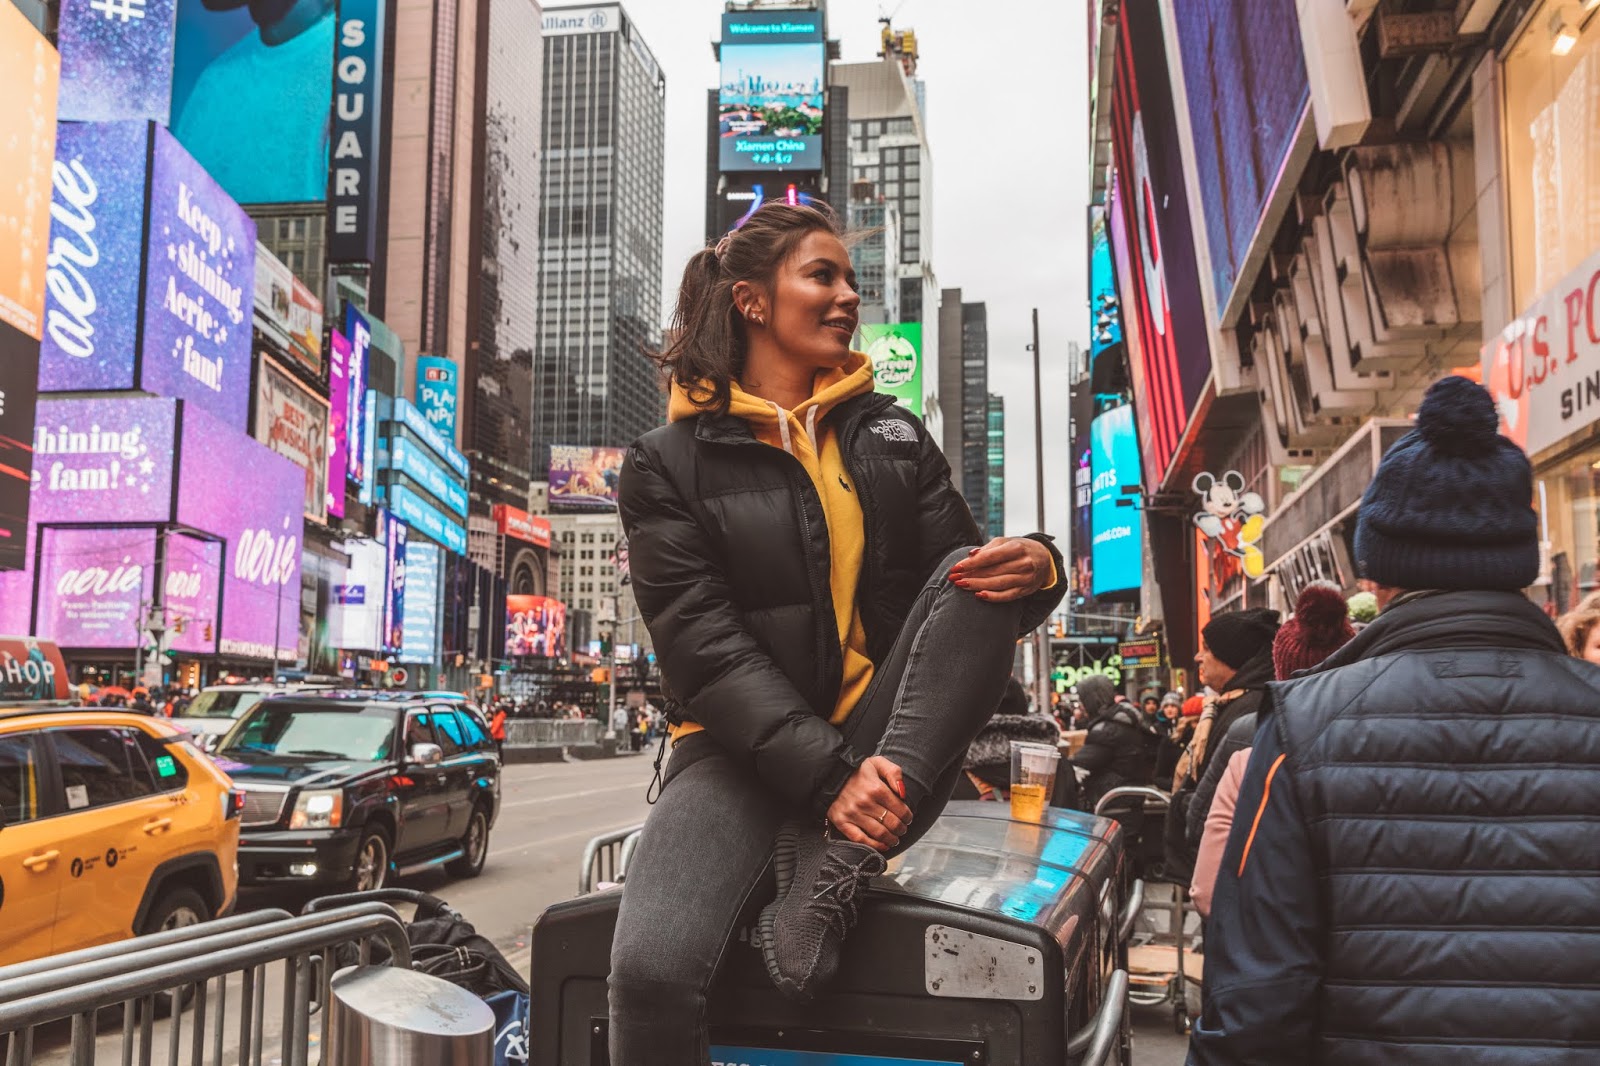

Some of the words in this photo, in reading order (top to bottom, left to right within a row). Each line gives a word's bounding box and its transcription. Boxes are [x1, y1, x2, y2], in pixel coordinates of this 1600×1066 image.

[729, 23, 770, 34] Welcome
[771, 24, 781, 33] to
[334, 19, 367, 233] SQUARE
[736, 140, 775, 152] Xiamen
[775, 139, 806, 151] China
[178, 182, 222, 257] Keep
[164, 275, 213, 339] Aerie
[183, 335, 223, 392] fam!
[876, 360, 913, 372] Green
[1506, 315, 1558, 400] U.S.
[869, 425, 901, 434] NORTH
[877, 419, 898, 427] THE
[883, 433, 907, 442] FACE
[33, 425, 148, 460] hining,
[49, 461, 120, 490] fam!
[235, 515, 297, 586] aerie
[57, 555, 142, 596] aerie
[0, 657, 55, 684] HOP
